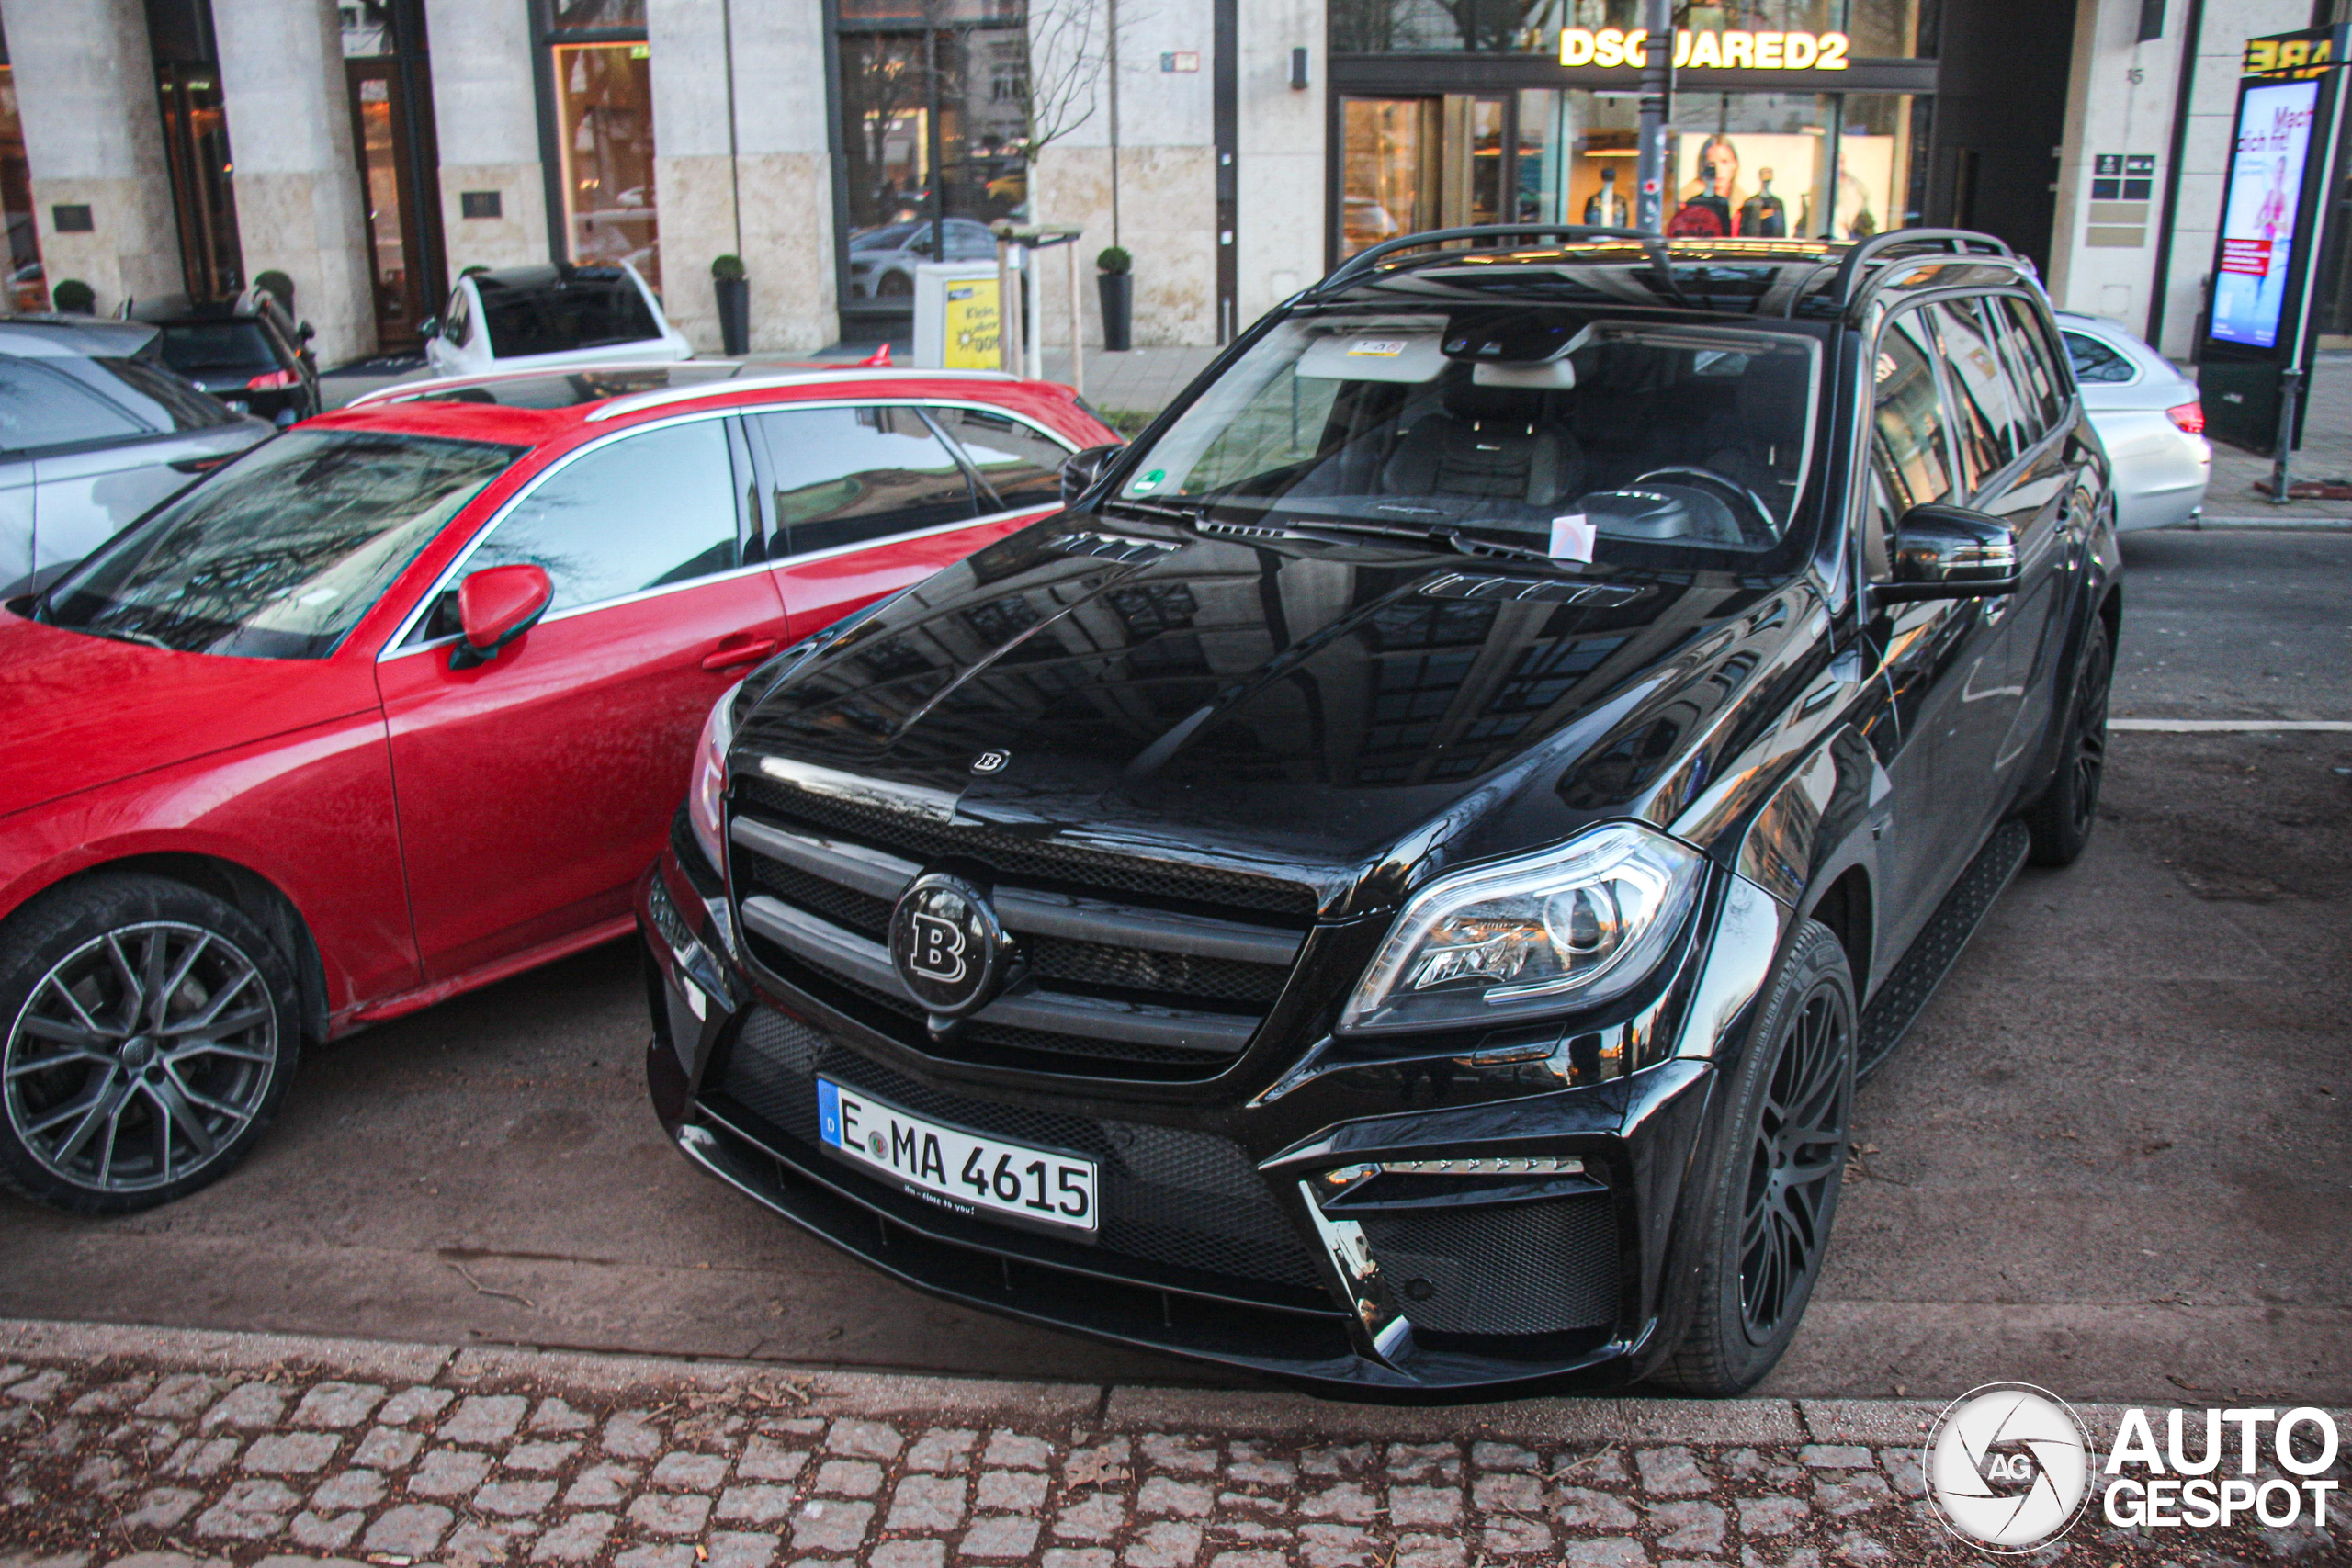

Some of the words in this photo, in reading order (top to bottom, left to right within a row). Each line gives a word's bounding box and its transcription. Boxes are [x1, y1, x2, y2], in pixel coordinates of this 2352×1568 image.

[910, 912, 967, 984] B
[827, 1117, 835, 1133] D
[842, 1098, 865, 1153] E
[891, 1119, 947, 1185] MA
[961, 1146, 1090, 1217] 4615
[922, 1192, 942, 1206] close
[944, 1200, 953, 1209] to
